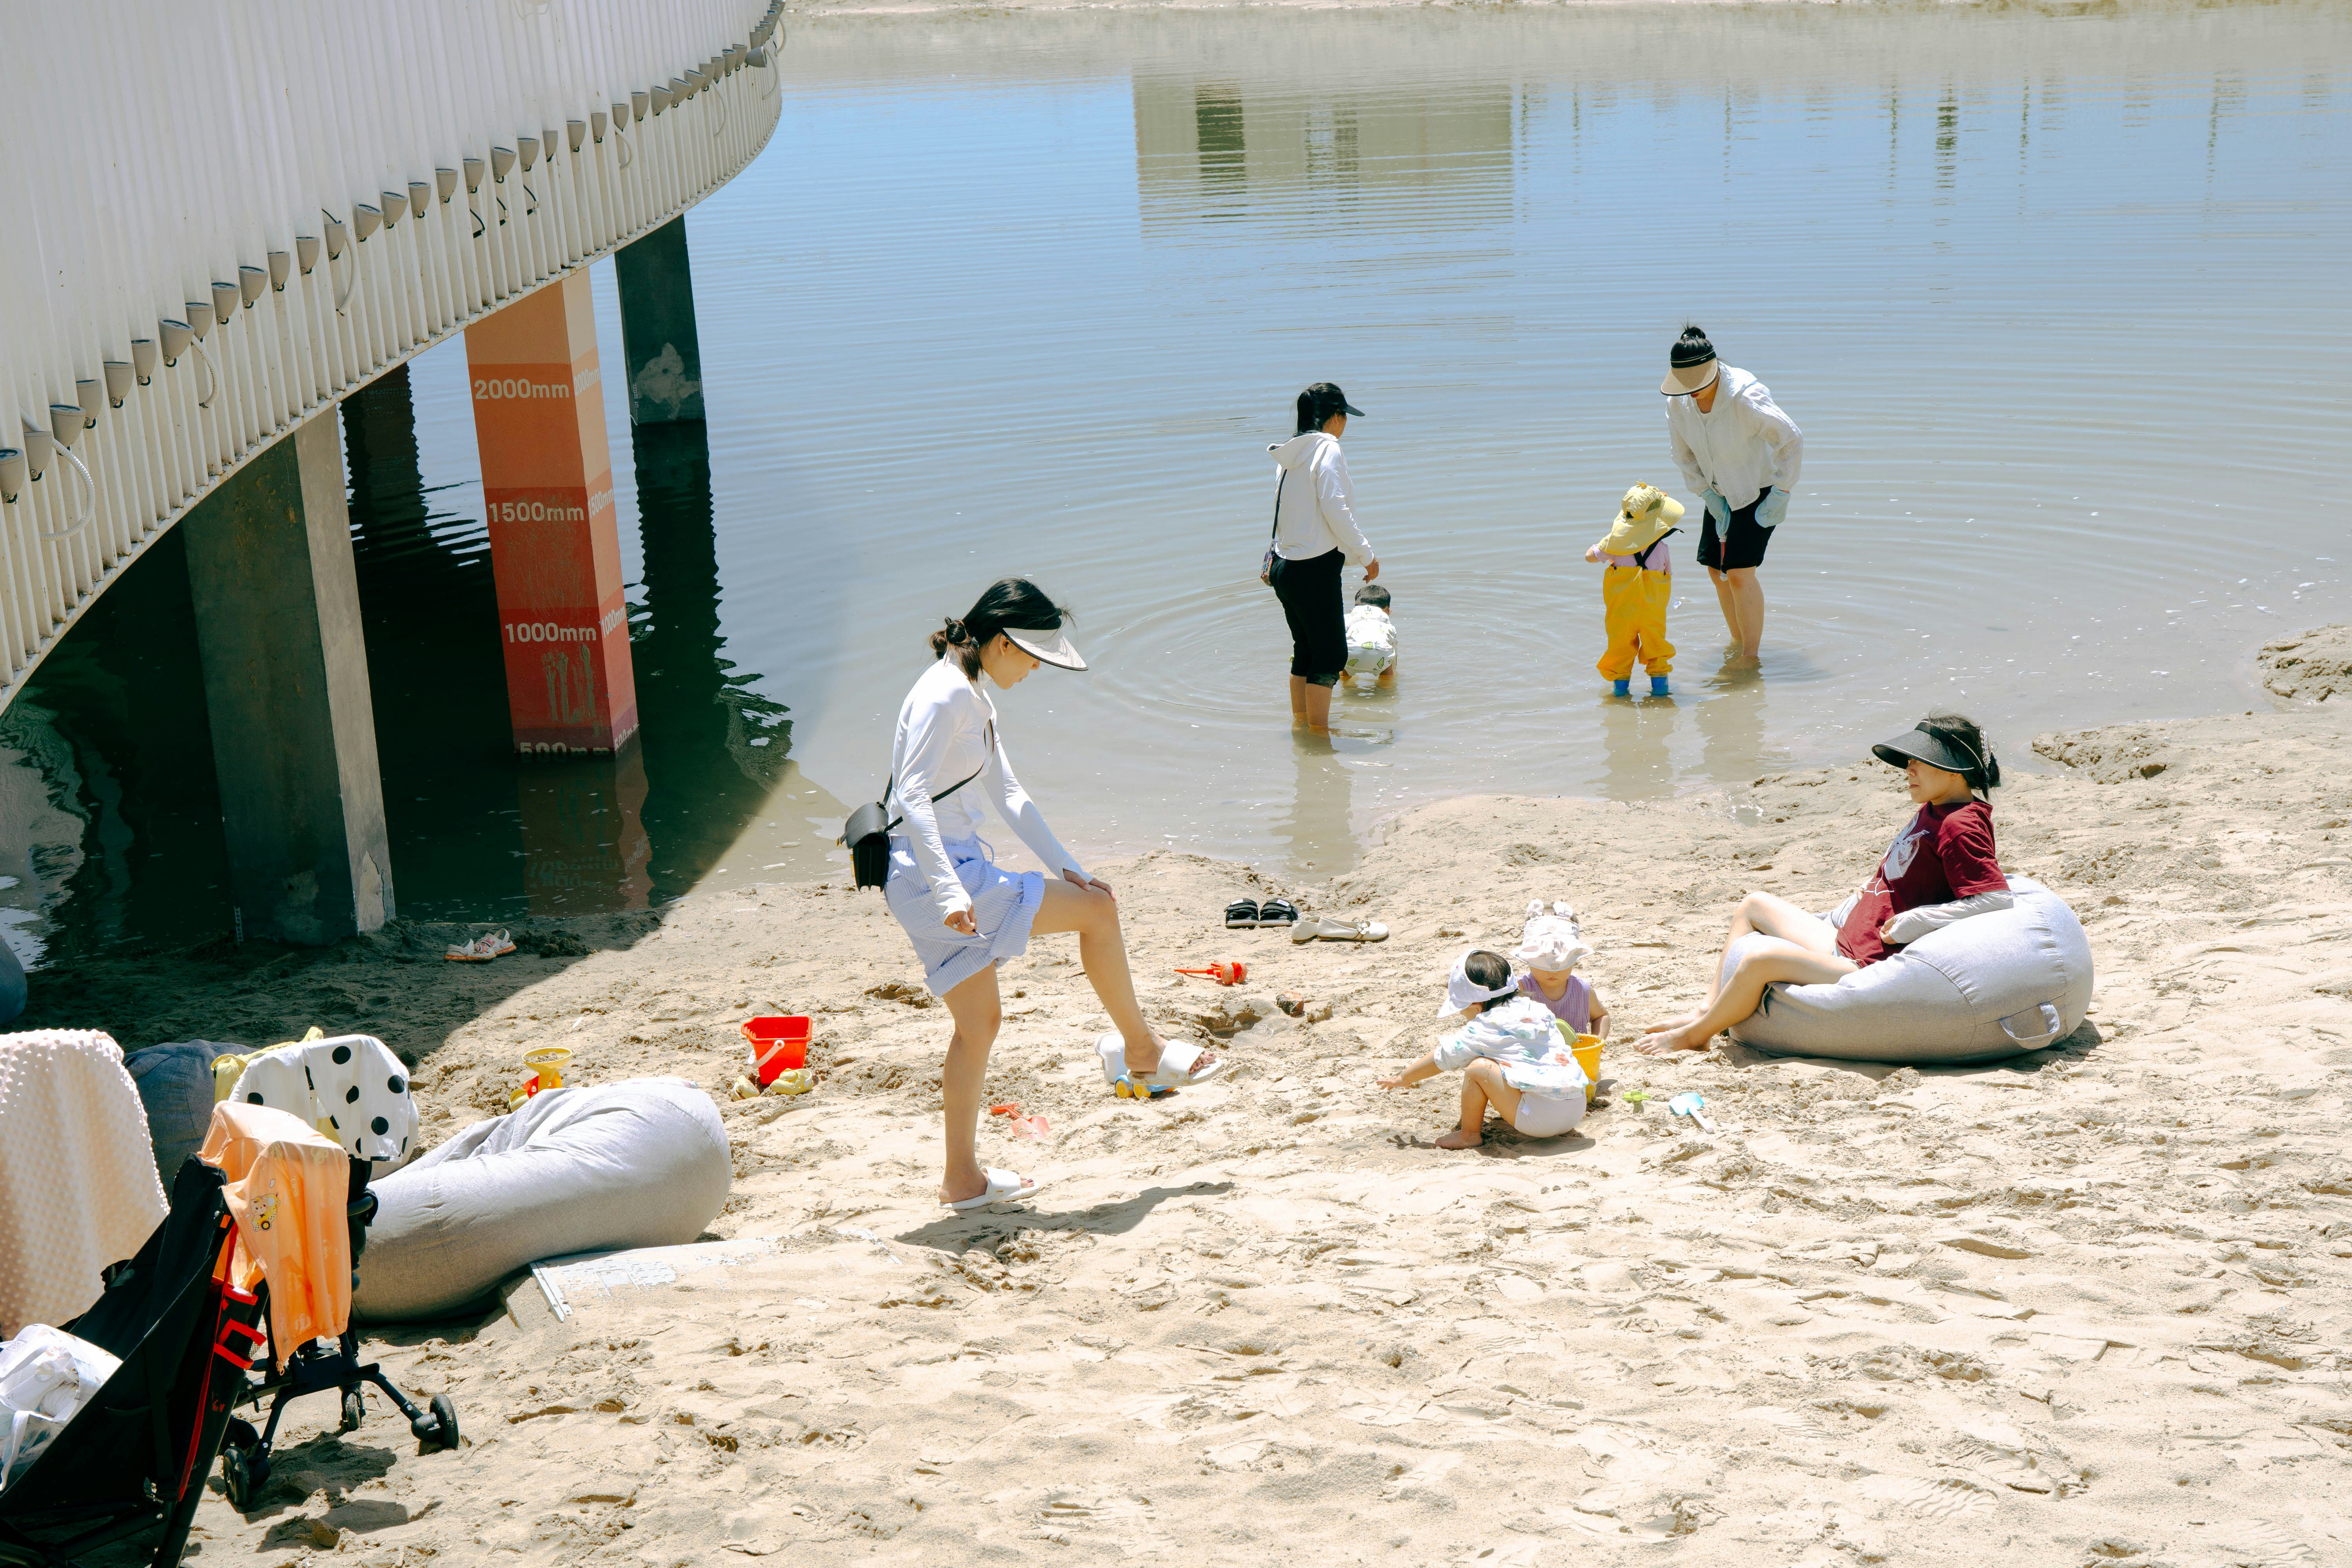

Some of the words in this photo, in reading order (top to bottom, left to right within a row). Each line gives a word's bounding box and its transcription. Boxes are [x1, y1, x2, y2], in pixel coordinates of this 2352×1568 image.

[475, 379, 568, 399] 2000mm
[574, 368, 600, 396] 2000mm
[489, 503, 584, 522] 1500mm
[588, 488, 614, 519] 1500mm
[505, 623, 596, 642] 1000mm
[601, 606, 626, 638] 1000mm
